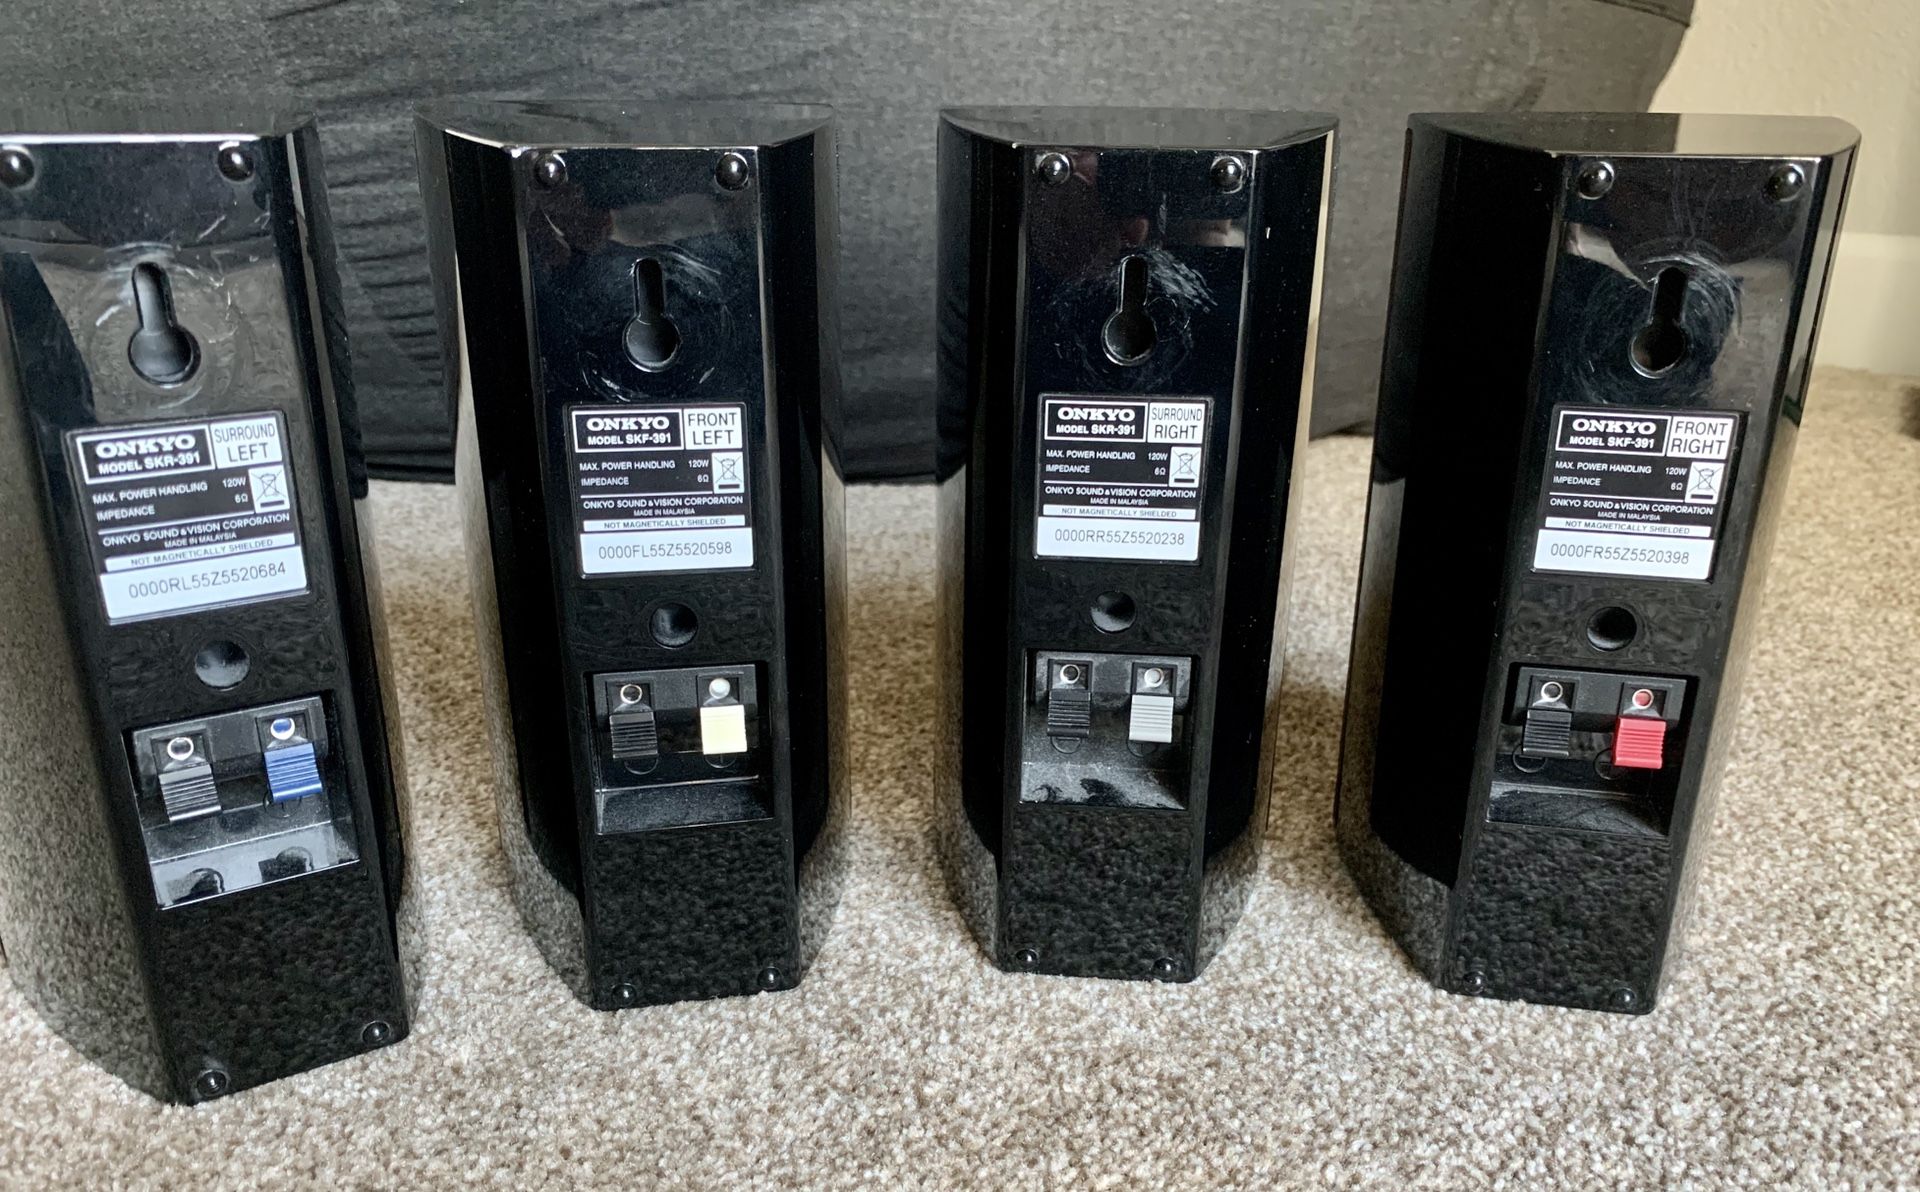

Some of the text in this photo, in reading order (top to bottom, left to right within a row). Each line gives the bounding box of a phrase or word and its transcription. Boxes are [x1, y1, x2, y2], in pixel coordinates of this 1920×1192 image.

[688, 413, 737, 426] FRONT
[1058, 407, 1135, 421] ONKYO
[1152, 408, 1202, 421] SURROUND
[586, 416, 669, 431] ONKYO
[1056, 424, 1135, 435] MODEL SKR-391
[1572, 419, 1656, 435] ONKYO
[1675, 421, 1728, 435] FRONT
[215, 423, 275, 442] SURROUND
[588, 433, 671, 445] MODEL SKF-391
[693, 430, 734, 445] LEFT
[1155, 425, 1198, 439] RIGHT
[95, 434, 196, 459] ONKYO
[1569, 436, 1654, 448] MODEL SKF-391
[1670, 438, 1726, 454] RIGHT
[227, 443, 269, 463] LEFT
[1046, 450, 1135, 459] MAX. POWER HANDLING
[98, 452, 200, 474] MODEL SKR-391
[580, 460, 675, 471] MAX. POWER HANDLING
[688, 460, 709, 468] 120W
[1555, 461, 1652, 473] MAX. POWER HANDLING
[1665, 467, 1687, 476] 120W
[223, 477, 246, 488] 120W
[581, 477, 629, 486] IMPEDANCE
[1553, 476, 1601, 485] IMPEDANCE
[93, 482, 208, 504] MAX. POWER HANDLING
[1110, 488, 1137, 496] VISION
[1139, 489, 1196, 498] CORPORATION
[583, 501, 614, 509] ONKYO
[617, 500, 647, 508] SOUND
[653, 498, 682, 506] VISION
[684, 497, 743, 505] CORPORATION
[1550, 498, 1581, 507] ONKYO
[1583, 500, 1613, 509] SOUND
[1620, 502, 1649, 511] VISION
[1652, 504, 1713, 515] CORPORATION
[96, 505, 155, 521] IMPEDANCE
[1079, 508, 1137, 516] MAGNETICALLY
[1627, 513, 1660, 521] MALAYSIA
[103, 534, 140, 547] ONKYO
[144, 529, 178, 541] SOUND
[187, 523, 220, 535] VISION
[223, 513, 290, 530] CORPORATION
[623, 520, 684, 528] MAGNETICALLY
[687, 518, 726, 526] SHIELDED
[1584, 522, 1647, 531] MAGNETICALLY
[1649, 525, 1690, 534] SHIELDED
[165, 539, 187, 548] MADE
[199, 532, 236, 544] MALAYSIA
[1055, 529, 1184, 545] 0000RR55Z5520238
[131, 539, 273, 566] NOT MAGNETICALLY SHIELDED
[599, 542, 732, 559] 0000FL55Z5520598
[1550, 543, 1689, 564] 0000FR55Z5520398
[129, 562, 285, 598] 0000RL55Z5520684
